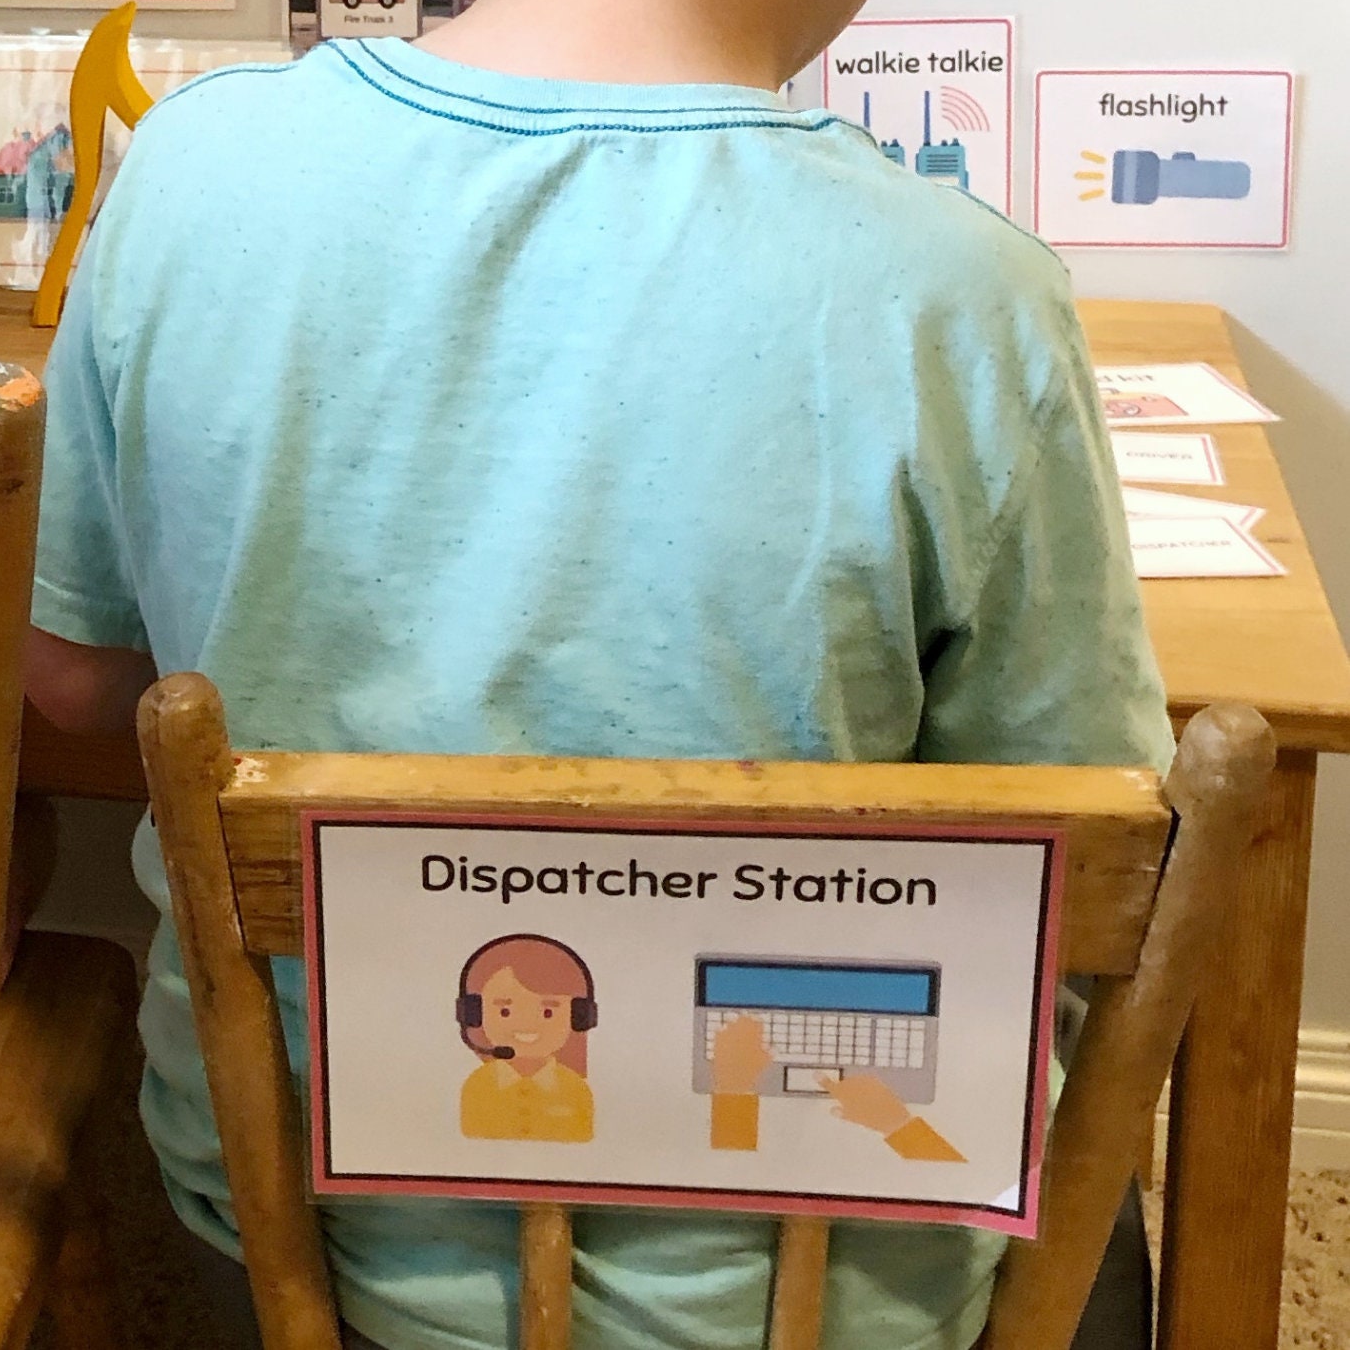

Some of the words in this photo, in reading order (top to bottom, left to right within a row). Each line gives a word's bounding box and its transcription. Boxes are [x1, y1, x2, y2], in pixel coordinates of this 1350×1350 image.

[835, 52, 921, 76] walkie
[927, 49, 1004, 74] talkie
[1099, 93, 1229, 123] flashlight
[421, 855, 717, 904] Dispatcher
[732, 864, 938, 907] Station
